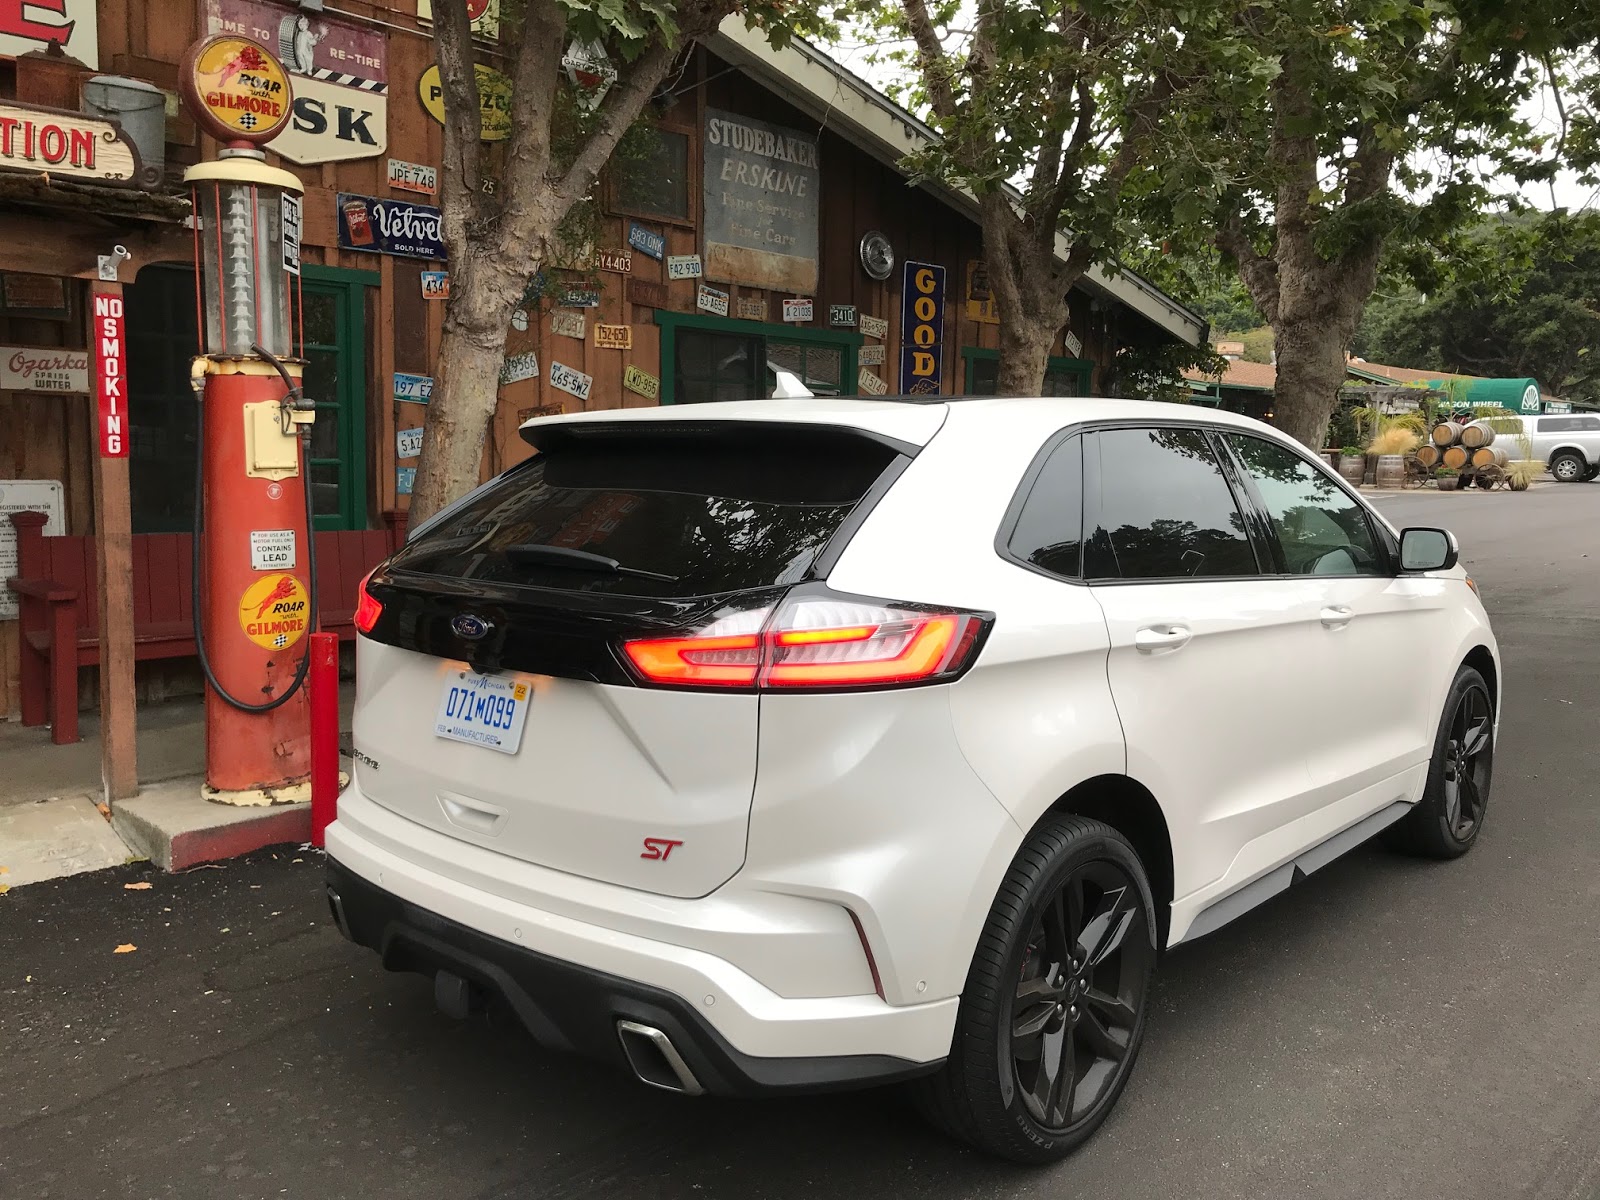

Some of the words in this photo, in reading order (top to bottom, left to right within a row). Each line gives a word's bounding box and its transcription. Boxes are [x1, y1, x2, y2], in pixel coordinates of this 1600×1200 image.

[212, 17, 246, 35] IME
[252, 27, 270, 41] TO
[329, 47, 381, 69] RE-TIRE
[238, 73, 282, 94] ROAR
[206, 91, 282, 118] GILMORE
[248, 90, 271, 100] with
[0, 116, 95, 170] TION
[708, 118, 819, 170] STUDEBAKER
[391, 168, 410, 184] JPE
[414, 172, 434, 188] 748
[720, 158, 808, 197] ERSKINE
[631, 227, 647, 245] 683
[765, 228, 797, 246] Cars
[394, 243, 414, 252] SOLD
[416, 247, 434, 255] HERE
[95, 297, 122, 318] NO
[833, 309, 854, 321] 3410
[912, 268, 937, 376] GOOD
[9, 351, 88, 378] Ozarka
[35, 371, 70, 380] SPRING
[35, 380, 71, 389] WATER
[102, 318, 121, 454] SMOKING
[395, 380, 414, 395] 197
[256, 544, 292, 552] CONTAINS
[263, 553, 288, 562] LEAD
[272, 601, 305, 614] ROAR
[246, 619, 304, 636] GILMORE
[517, 686, 526, 695] 22
[446, 687, 516, 730] 071M099
[437, 724, 447, 733] FEB
[452, 726, 499, 744] MANUFACTURER
[640, 837, 684, 861] ST
